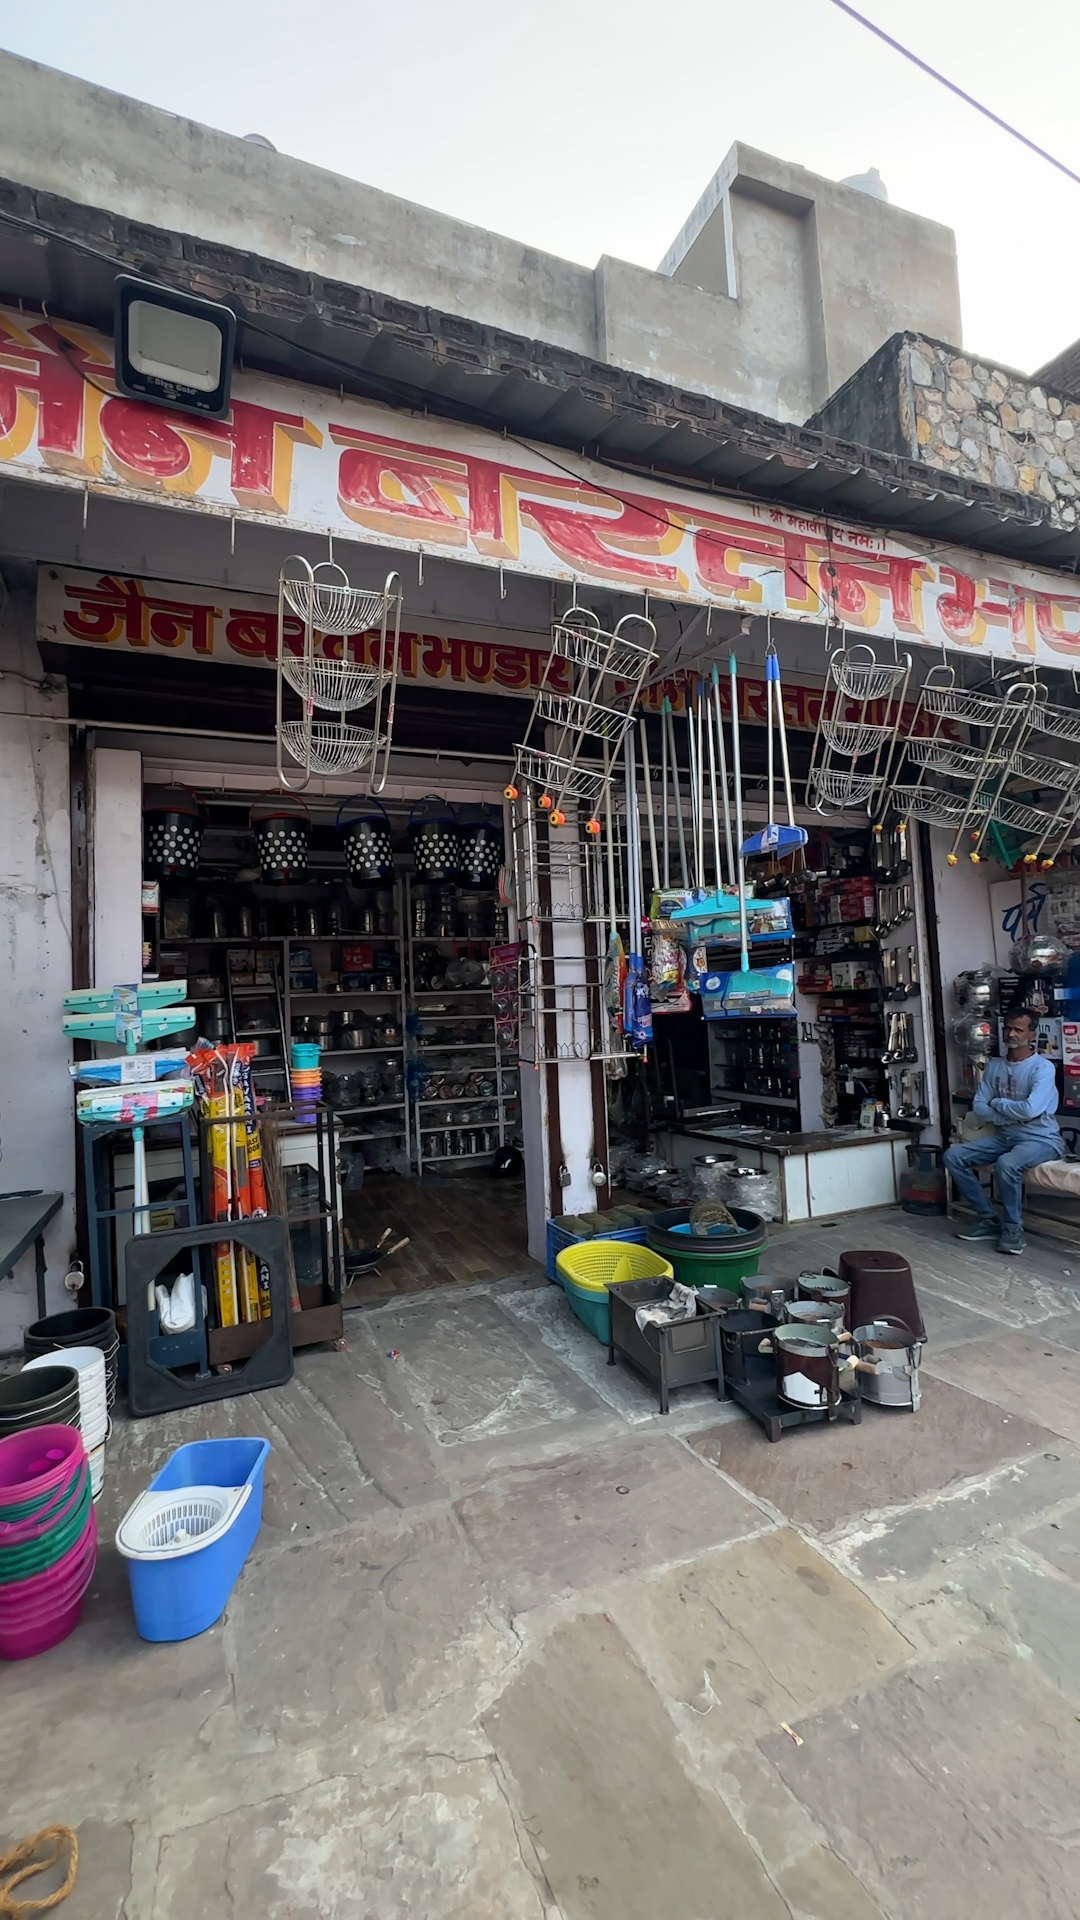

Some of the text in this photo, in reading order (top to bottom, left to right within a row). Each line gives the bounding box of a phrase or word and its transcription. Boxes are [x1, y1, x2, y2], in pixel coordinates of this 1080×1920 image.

[176, 384, 197, 396] Gold
[327, 422, 935, 634] बरतन
[769, 507, 784, 524] श्री
[847, 530, 874, 550] नमः
[63, 575, 573, 694] जैन बरतन भण्डार
